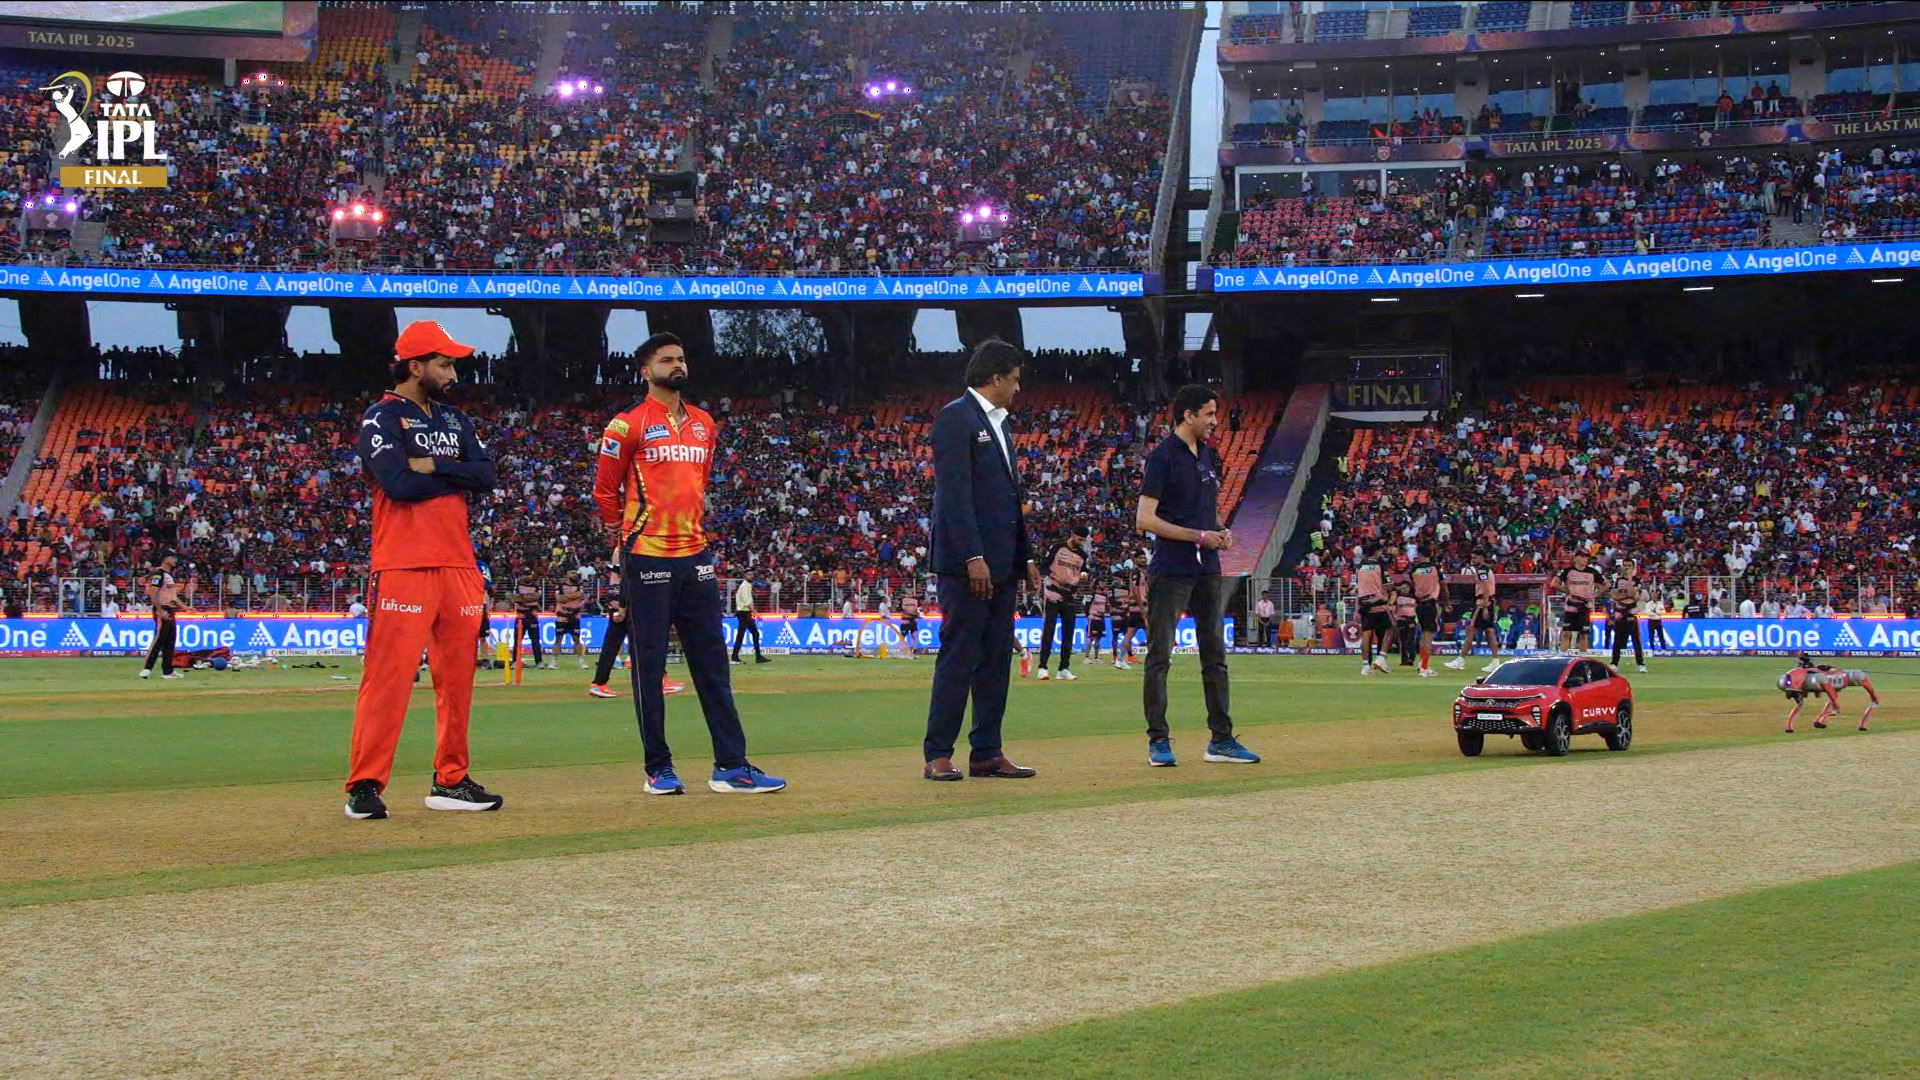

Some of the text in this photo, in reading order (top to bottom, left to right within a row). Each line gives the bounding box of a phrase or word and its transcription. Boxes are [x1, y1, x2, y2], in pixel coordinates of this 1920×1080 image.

[28, 31, 135, 48] TATA IPL 2025
[1832, 118, 1920, 135] THE LAST M
[1505, 138, 1601, 153] TATA IPL 2025
[1214, 272, 1244, 287] One
[1274, 270, 1358, 289] AngelOne
[1388, 268, 1474, 288] AngelOne
[1504, 263, 1592, 283] AngelOne
[1622, 257, 1712, 277] AngelOne
[1744, 251, 1837, 272] AngelOne
[0, 270, 1143, 298] One AngelOne AngelOne AngelOne AngelOne AngelOne AngelOne AngelOne AngelOne AngelOne AngelOne Angel
[1348, 384, 1427, 406] FINAL
[640, 571, 672, 580] kshema
[0, 624, 47, 648] One
[95, 623, 236, 651] AnglOne
[807, 623, 932, 650] AngelOe
[1681, 623, 1820, 651] AngelOne
[1582, 706, 1617, 718] CURVV
